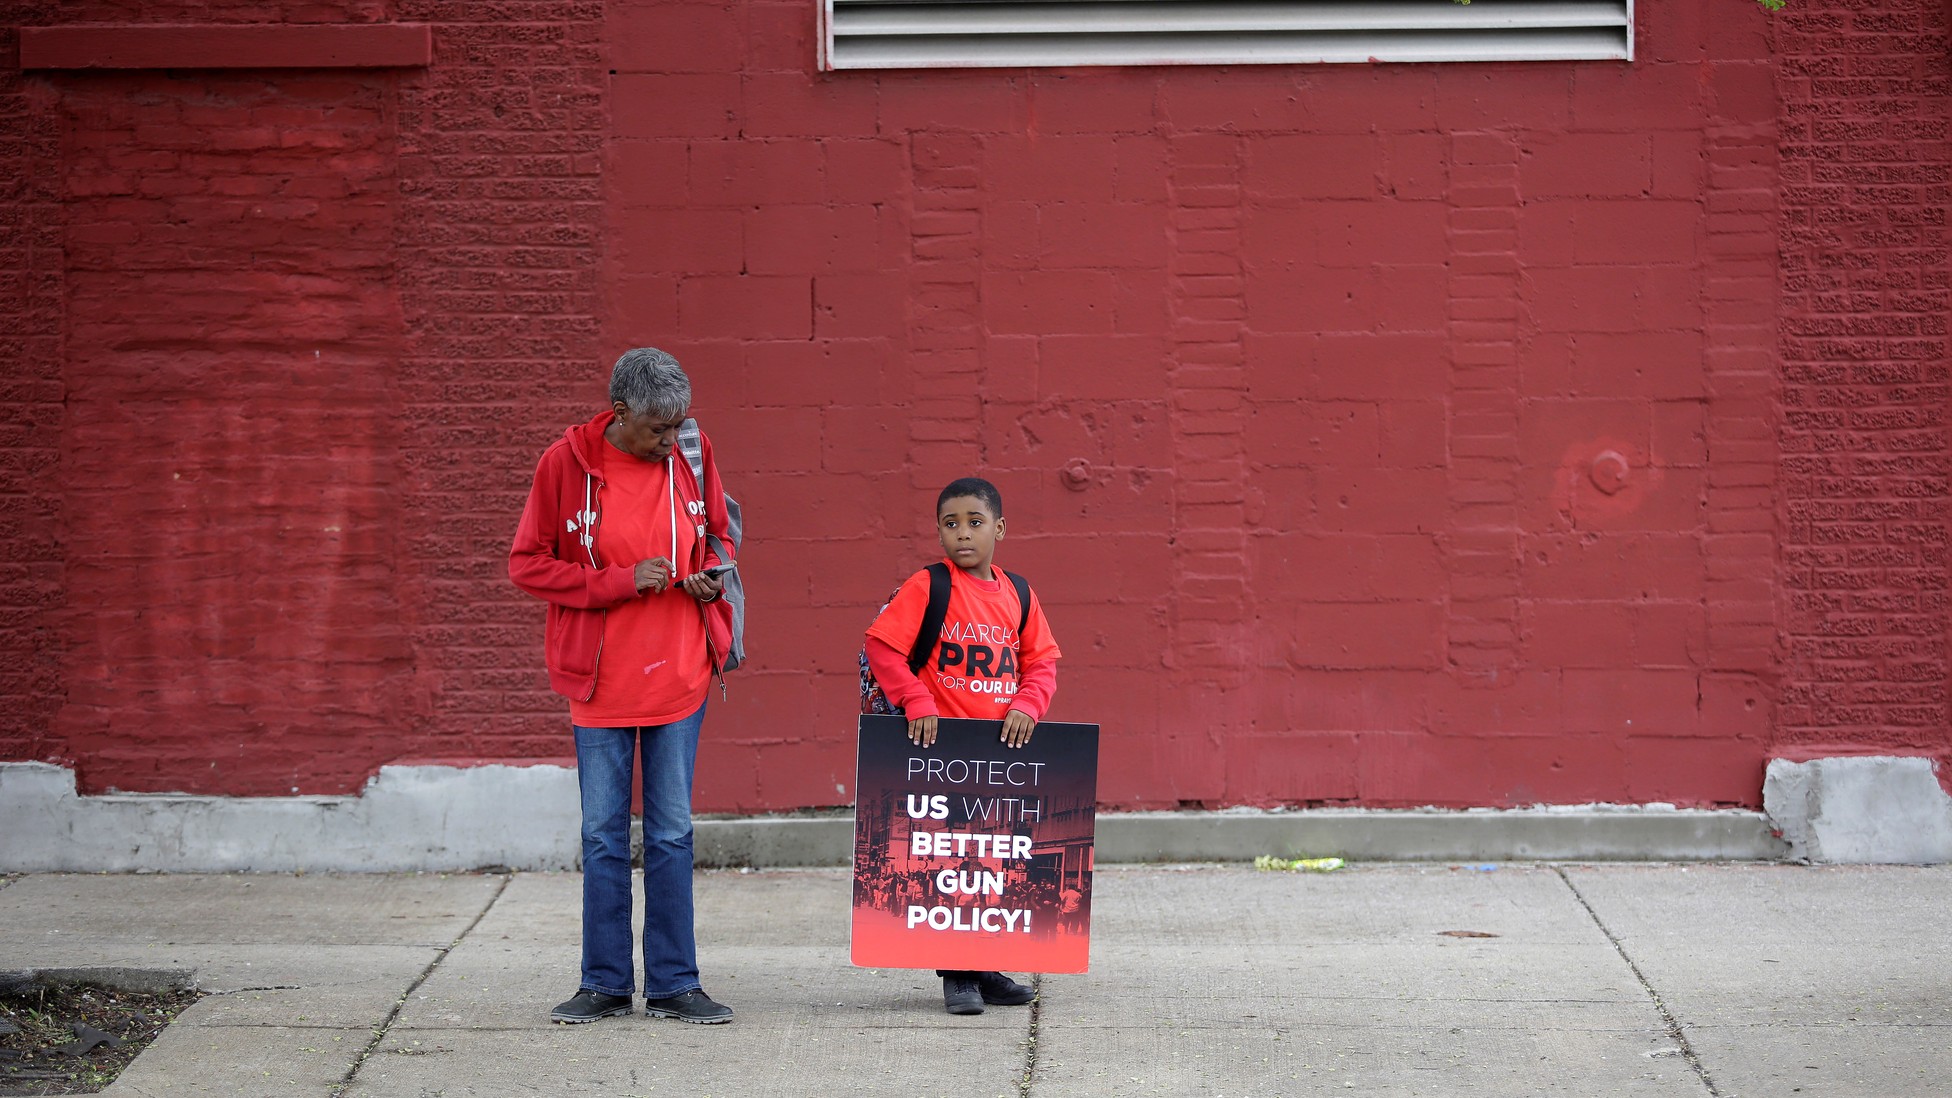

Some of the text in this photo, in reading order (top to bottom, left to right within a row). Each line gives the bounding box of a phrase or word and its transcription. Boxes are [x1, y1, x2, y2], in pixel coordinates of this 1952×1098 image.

[940, 621, 1014, 644] MARCH
[970, 679, 1002, 694] OUR
[907, 757, 1046, 787] PROTECT
[907, 794, 950, 820] US
[962, 796, 1041, 823] WITH
[911, 831, 1033, 860] BETTER
[936, 869, 1004, 896] GUN
[907, 905, 1033, 933] POLICY!
